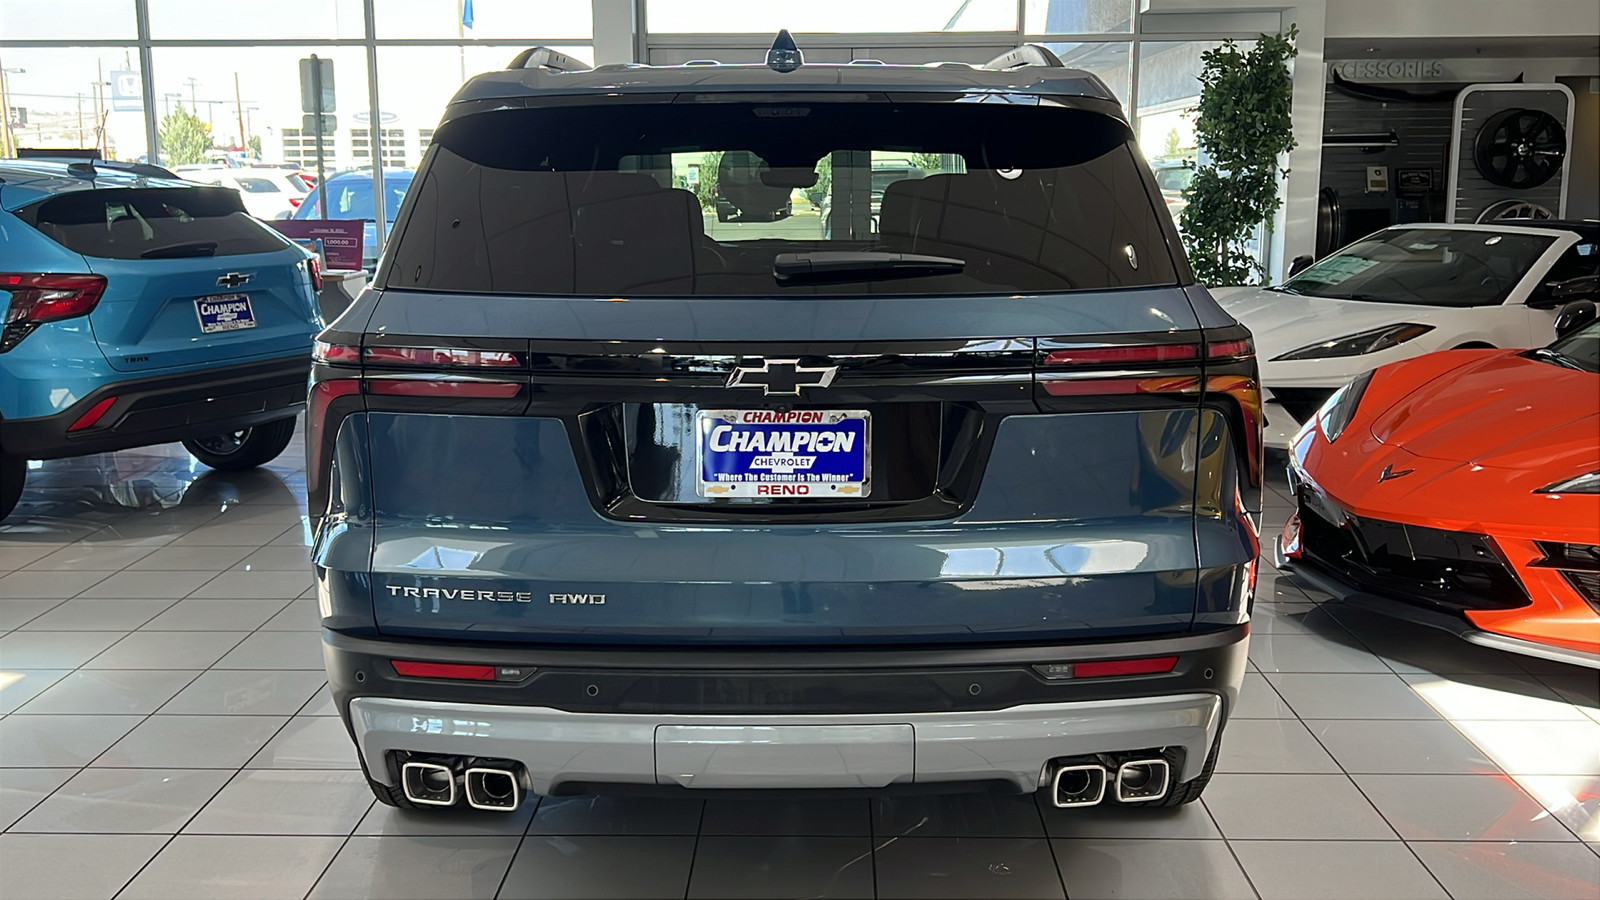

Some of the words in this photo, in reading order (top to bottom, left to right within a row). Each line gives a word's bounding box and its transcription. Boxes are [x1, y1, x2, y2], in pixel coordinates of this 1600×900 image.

[1327, 60, 1442, 79] CCESSORIES
[200, 302, 247, 316] CHAMPION
[743, 411, 823, 424] CHAMPION
[709, 424, 856, 453] CHAMPION
[754, 457, 812, 468] CHEVROLET
[744, 472, 759, 482] The
[760, 472, 796, 482] Customer
[806, 473, 821, 482] The
[757, 484, 810, 495] RENO
[386, 585, 532, 603] TRAVERSE
[549, 593, 606, 605] AWD
